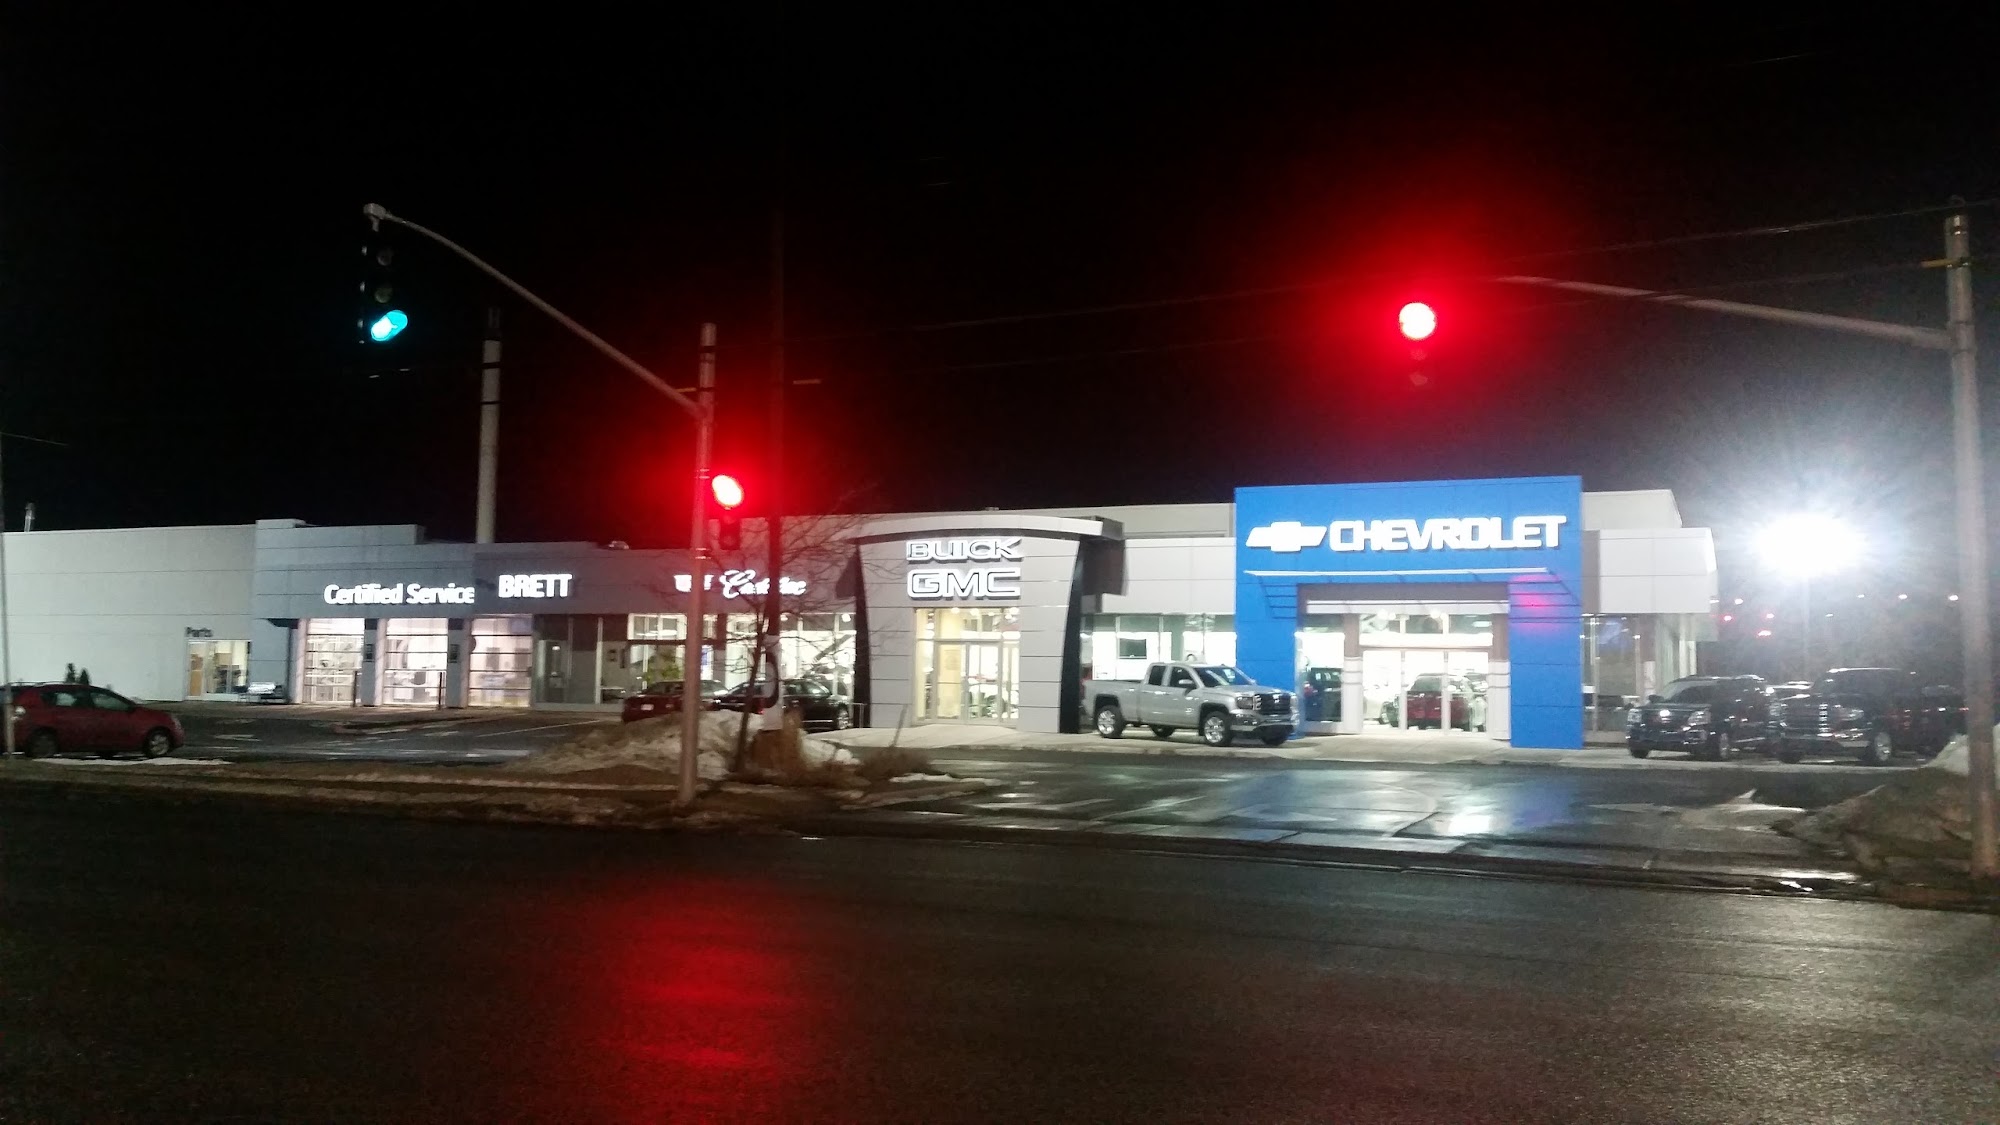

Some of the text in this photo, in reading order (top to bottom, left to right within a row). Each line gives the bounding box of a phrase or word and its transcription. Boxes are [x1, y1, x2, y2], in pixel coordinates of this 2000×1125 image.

[1329, 515, 1567, 551] CHEVROLET
[906, 537, 1023, 563] BUICK
[323, 582, 475, 604] Certified Service
[498, 573, 573, 598] BRETT
[719, 569, 807, 599] Cadlac
[907, 567, 1021, 600] GMC
